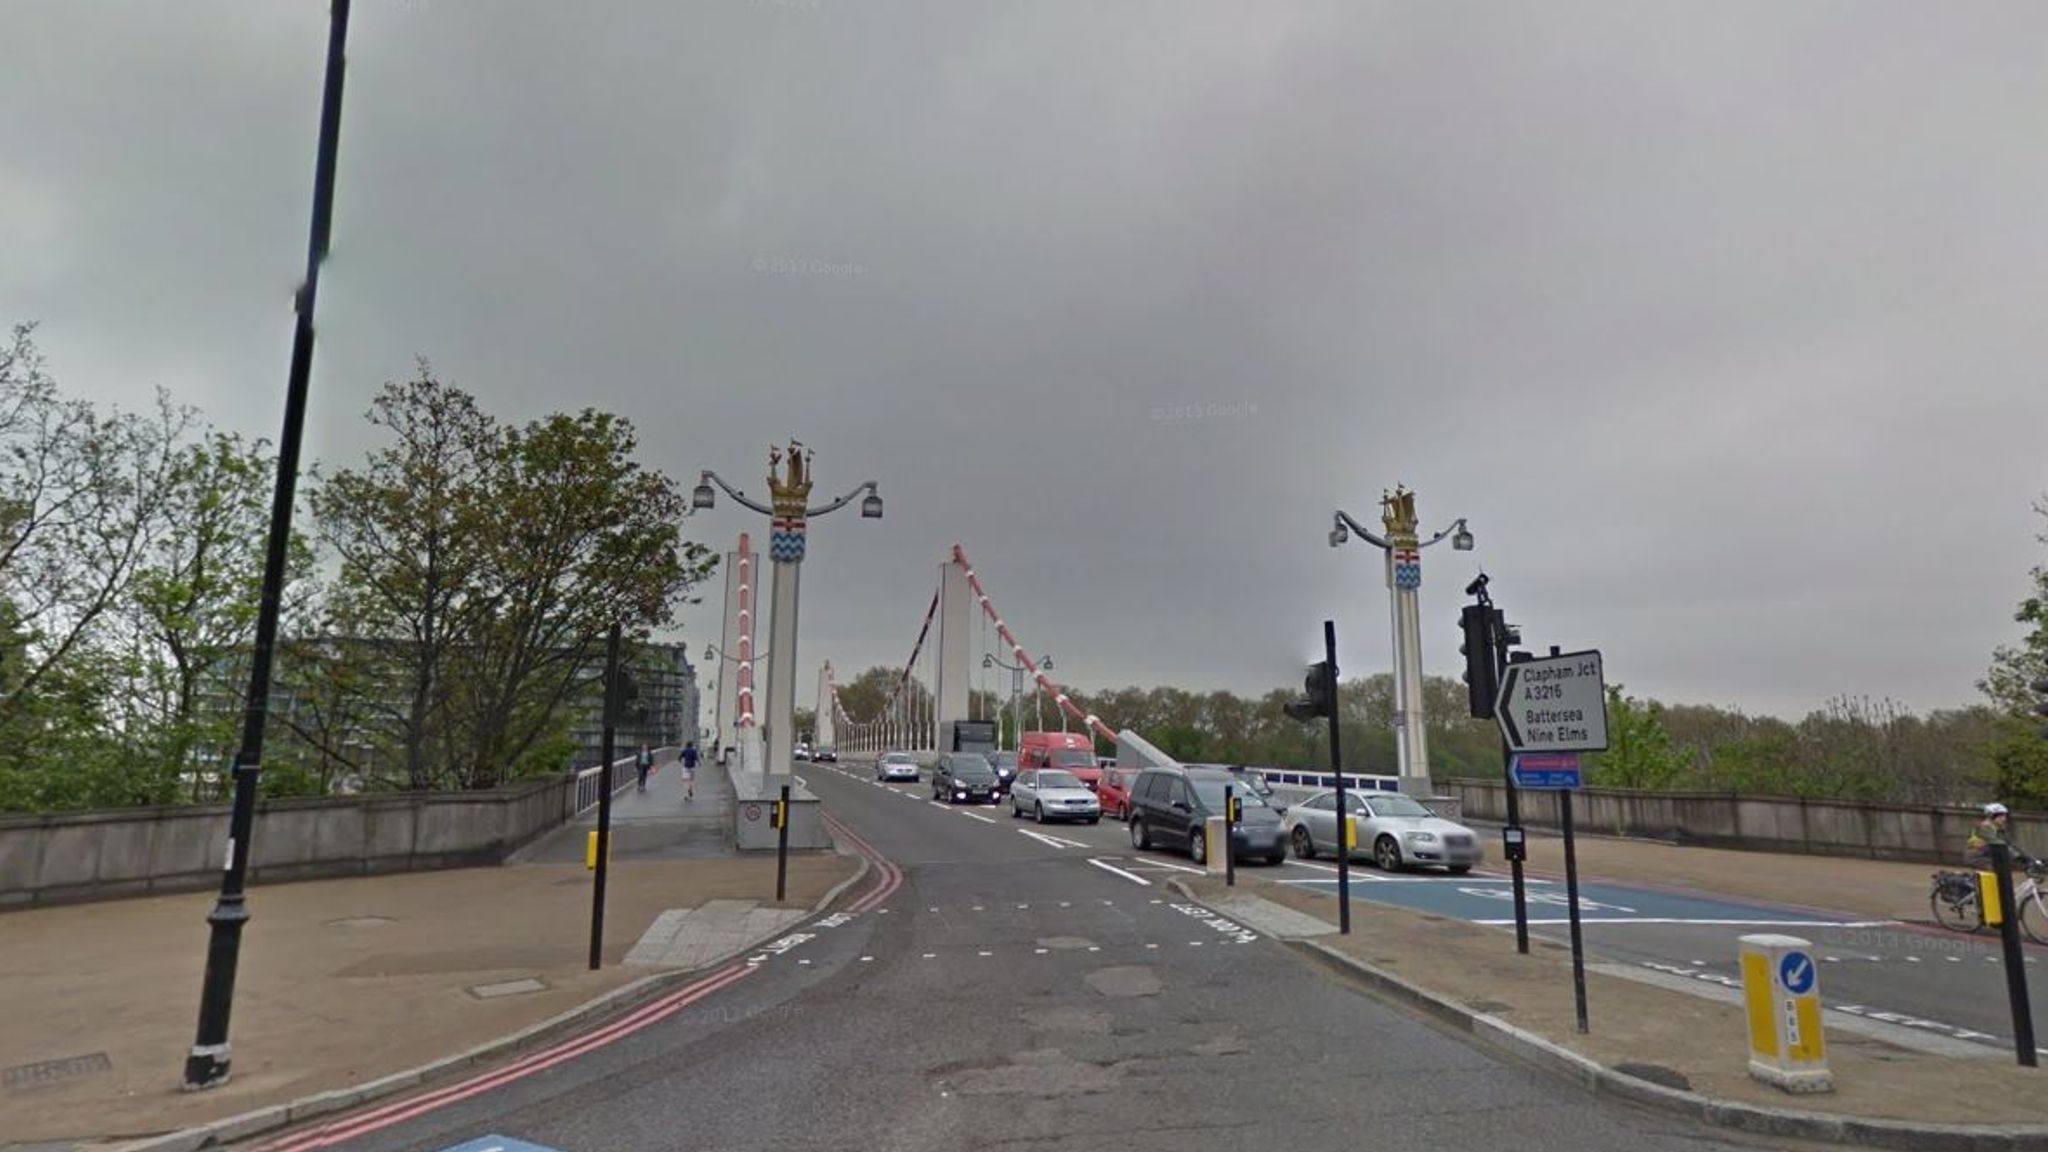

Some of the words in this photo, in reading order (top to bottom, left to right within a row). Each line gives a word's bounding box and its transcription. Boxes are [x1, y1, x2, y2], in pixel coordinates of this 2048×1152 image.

[1524, 666, 1574, 683] Clapham
[1577, 661, 1597, 677] Jct
[1526, 708, 1583, 724] Battersea
[1527, 728, 1554, 743] Nine
[1558, 726, 1588, 742] Elms
